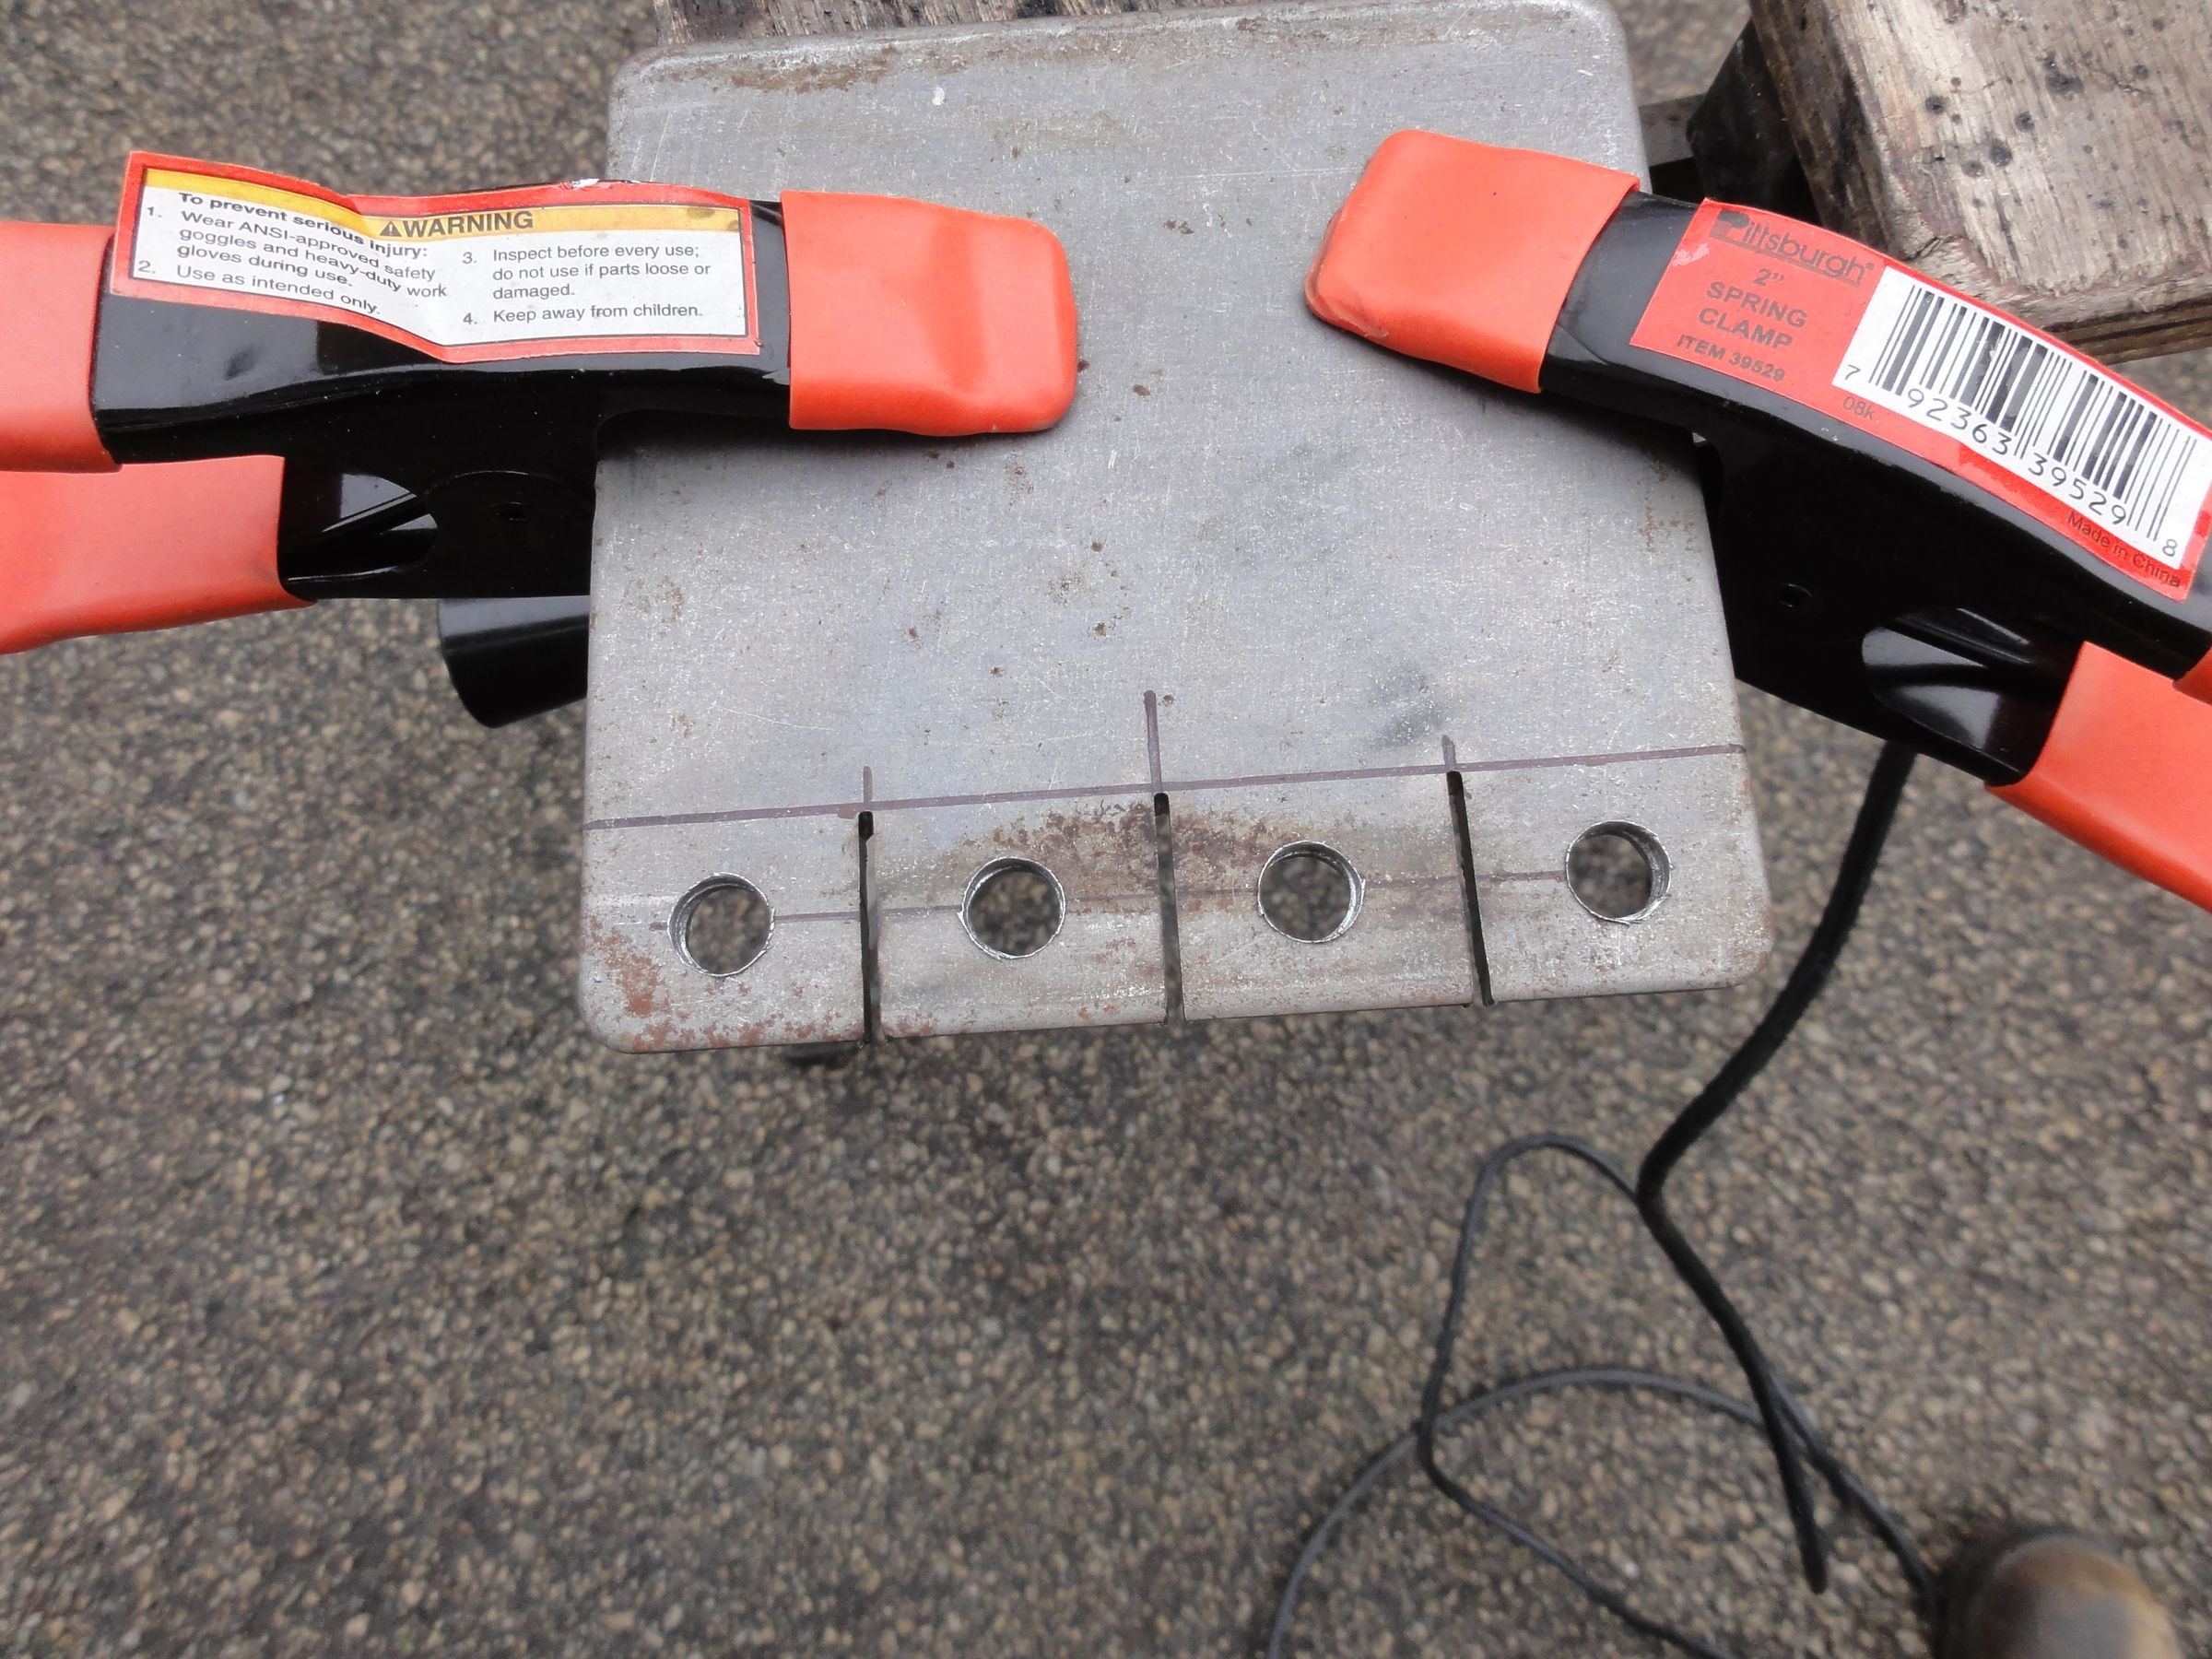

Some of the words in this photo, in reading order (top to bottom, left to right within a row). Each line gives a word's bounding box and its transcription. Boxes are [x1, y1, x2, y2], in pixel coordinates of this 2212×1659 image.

[147, 206, 162, 218] 1.
[179, 193, 203, 205] To
[209, 197, 287, 222] prevent
[293, 216, 364, 245] serious
[370, 240, 428, 259] injury:
[402, 211, 534, 238] WARNING
[177, 244, 241, 263] gloves
[249, 253, 308, 276] during
[315, 270, 353, 288] use.
[180, 229, 256, 250] goggles
[264, 241, 299, 257] and
[305, 251, 401, 292] heavy-duty
[407, 285, 447, 298] work
[182, 210, 231, 229] Wear
[239, 221, 379, 268] ANSI-approved
[385, 264, 436, 282] safety
[463, 252, 477, 264] 3.
[493, 247, 552, 264] Inspect
[558, 245, 609, 258] before
[615, 245, 659, 258] every
[665, 246, 700, 258] use;
[1710, 210, 1865, 281] Pittsburgh
[138, 261, 156, 274] 2.
[493, 267, 513, 280] do
[519, 266, 545, 278] not
[550, 266, 579, 277] use
[584, 264, 594, 276] if
[599, 264, 640, 278] parts
[645, 262, 688, 275] loose
[694, 264, 711, 275] or
[177, 265, 216, 280] Use
[222, 271, 244, 285] as
[253, 276, 335, 300] intended
[340, 294, 381, 314] only.
[493, 283, 575, 301] damaged.
[1706, 281, 1806, 328] SPRING
[463, 312, 477, 324] 4.
[493, 309, 536, 325] Keep
[542, 308, 585, 323] away
[591, 304, 628, 317] from
[633, 303, 702, 317] children.
[1699, 308, 1793, 349] CLAMP
[1677, 335, 1726, 360] ITEM
[1730, 352, 1785, 382] 39529
[1908, 388, 2013, 456] 92363
[2029, 453, 2128, 525] 39529
[2065, 512, 2111, 548] Made
[2112, 535, 2129, 556] in
[2132, 552, 2181, 588] China
